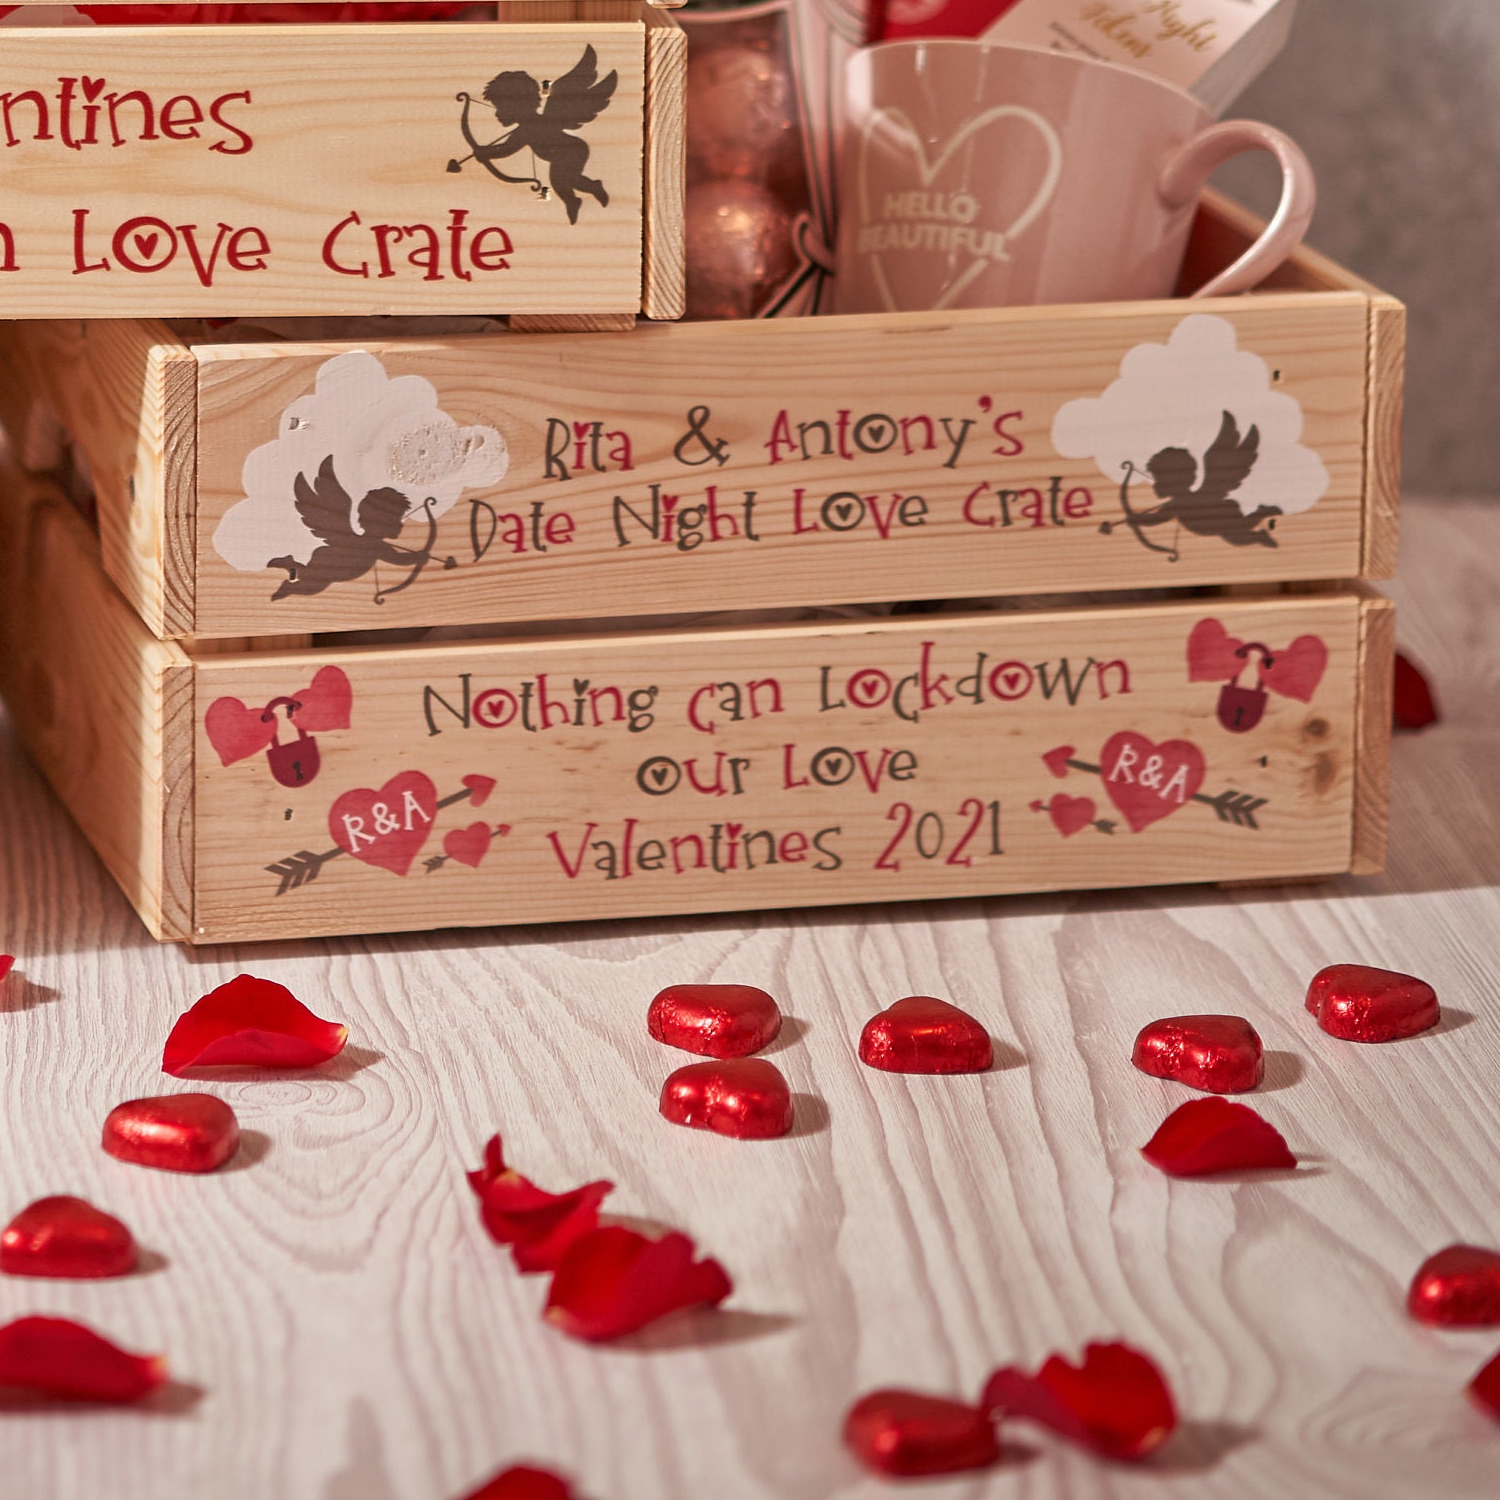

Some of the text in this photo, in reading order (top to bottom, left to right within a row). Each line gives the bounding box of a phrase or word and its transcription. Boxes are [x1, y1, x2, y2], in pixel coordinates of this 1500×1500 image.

[884, 191, 979, 224] HELLO
[72, 209, 272, 288] Love
[321, 209, 515, 282] Crate
[543, 395, 1025, 481] Rita & Antony's
[469, 476, 1094, 563] Date Night Love Crate
[423, 641, 1133, 737] Nothing can Lockdown
[636, 743, 919, 796] our Love
[1108, 743, 1190, 804] R&A
[341, 790, 431, 853] R&A
[546, 799, 1005, 881] Valentines 2021
